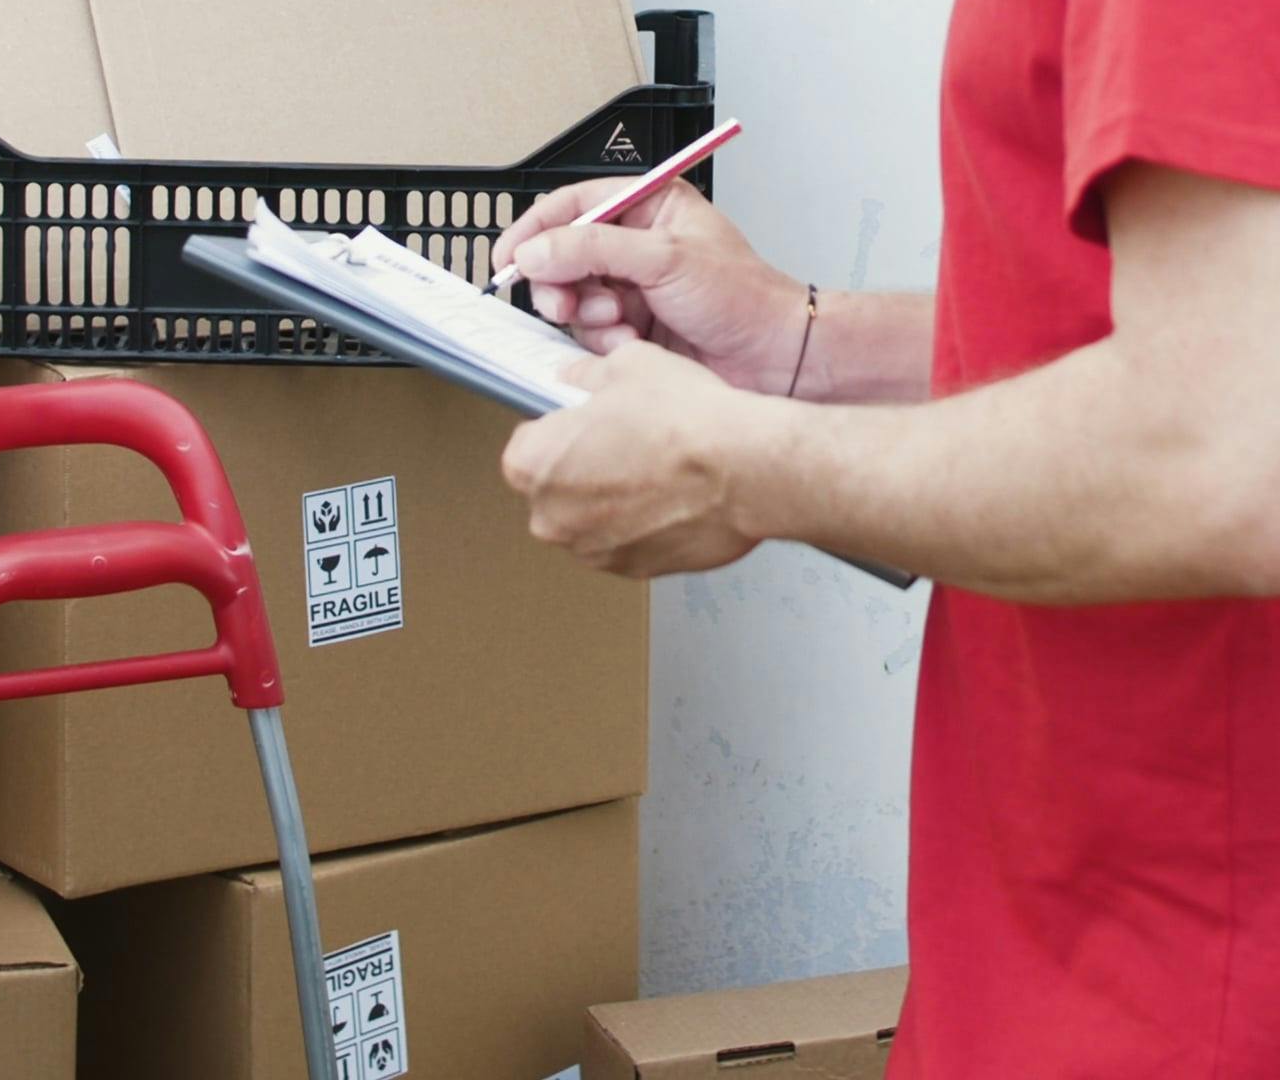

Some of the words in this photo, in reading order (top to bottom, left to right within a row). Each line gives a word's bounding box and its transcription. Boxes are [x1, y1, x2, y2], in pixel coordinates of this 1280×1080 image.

[311, 586, 400, 622] FRAGILE
[384, 614, 400, 622] CARE
[325, 954, 394, 992] FRAGIL
